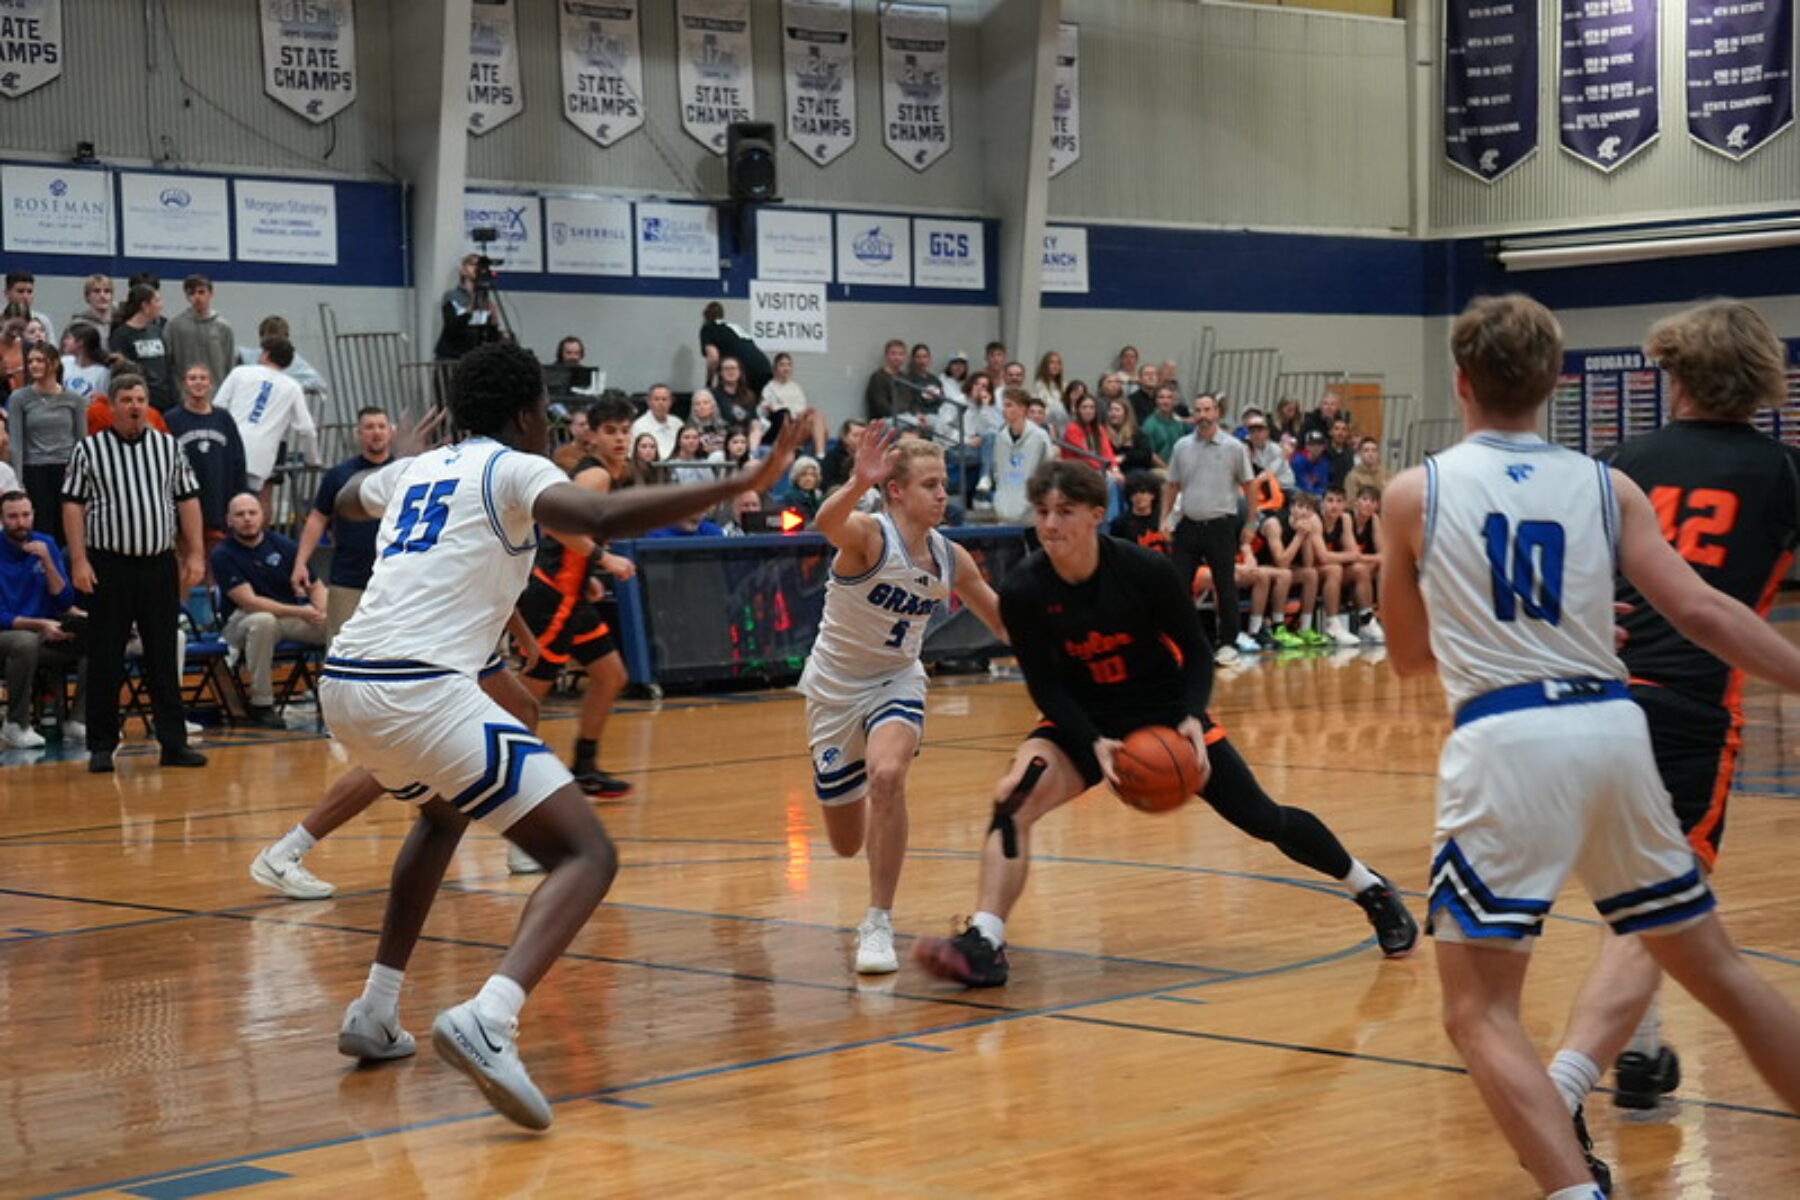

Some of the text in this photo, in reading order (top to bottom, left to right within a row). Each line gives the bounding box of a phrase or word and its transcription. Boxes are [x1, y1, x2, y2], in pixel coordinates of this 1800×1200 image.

[280, 45, 340, 69] STATE
[273, 66, 353, 91] CHAMPS
[577, 73, 625, 96] STATE
[567, 93, 638, 117] CHAMPS
[695, 84, 740, 106] STATE
[686, 104, 750, 125] CHAMPS
[797, 96, 841, 118] STATE
[898, 103, 940, 122] STATE
[792, 114, 851, 137] CHAMPS
[889, 123, 945, 142] CHAMPS
[13, 198, 105, 214] ROSEMAN
[569, 226, 627, 240] SHERRILL
[929, 231, 970, 258] GCS
[756, 292, 821, 312] VISITOR
[754, 320, 824, 340] SEATING
[1585, 353, 1641, 370] COUGARS
[381, 479, 461, 559] 55
[1480, 512, 1566, 627] 10
[884, 619, 911, 649] 5
